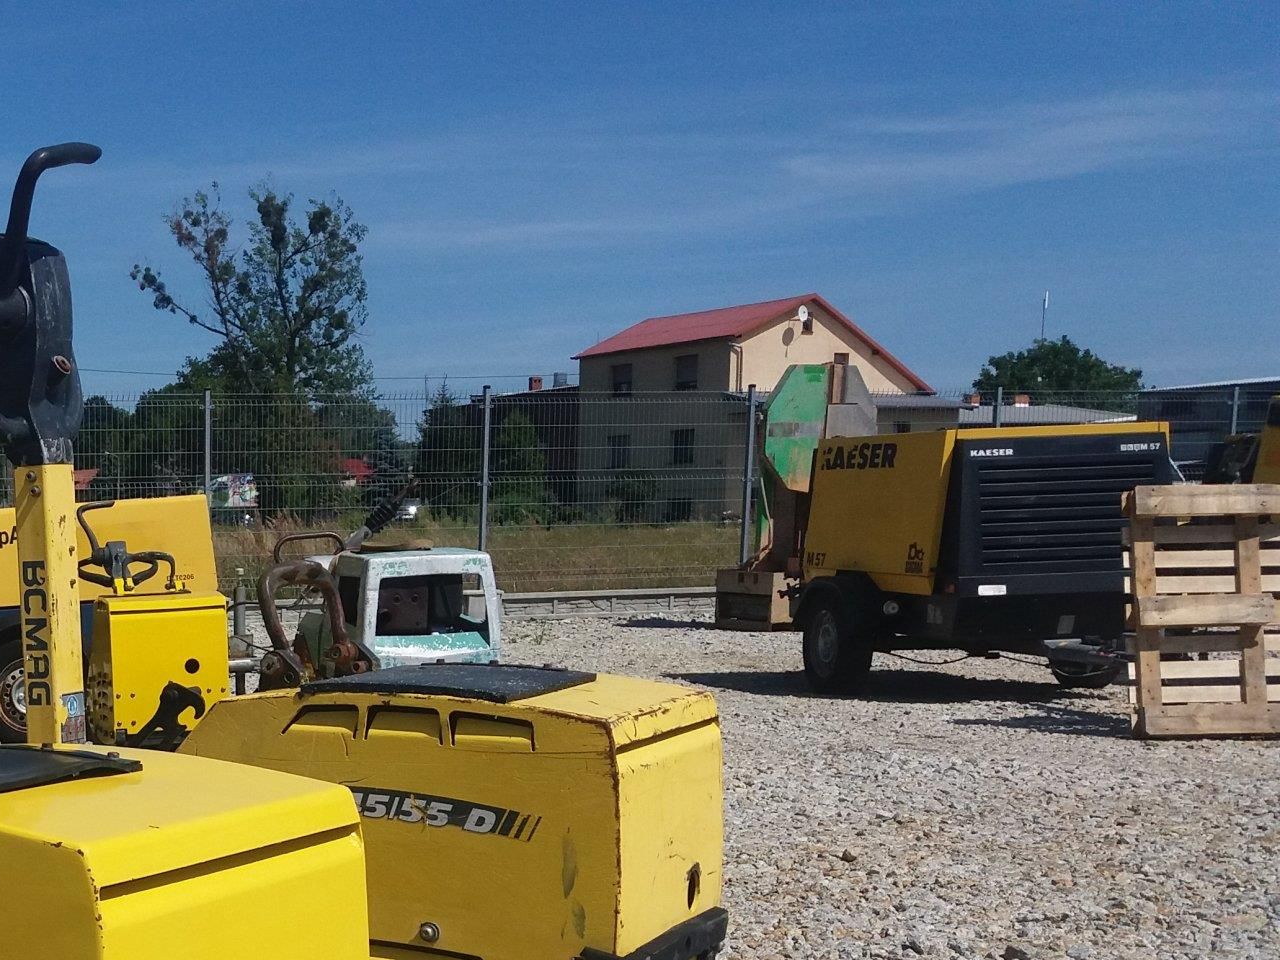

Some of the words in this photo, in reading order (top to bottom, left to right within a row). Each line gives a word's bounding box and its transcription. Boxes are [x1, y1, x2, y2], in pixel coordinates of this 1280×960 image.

[822, 443, 898, 471] KAESER
[970, 448, 1014, 457] KAESER
[815, 552, 827, 567] 57
[463, 807, 498, 834] D
